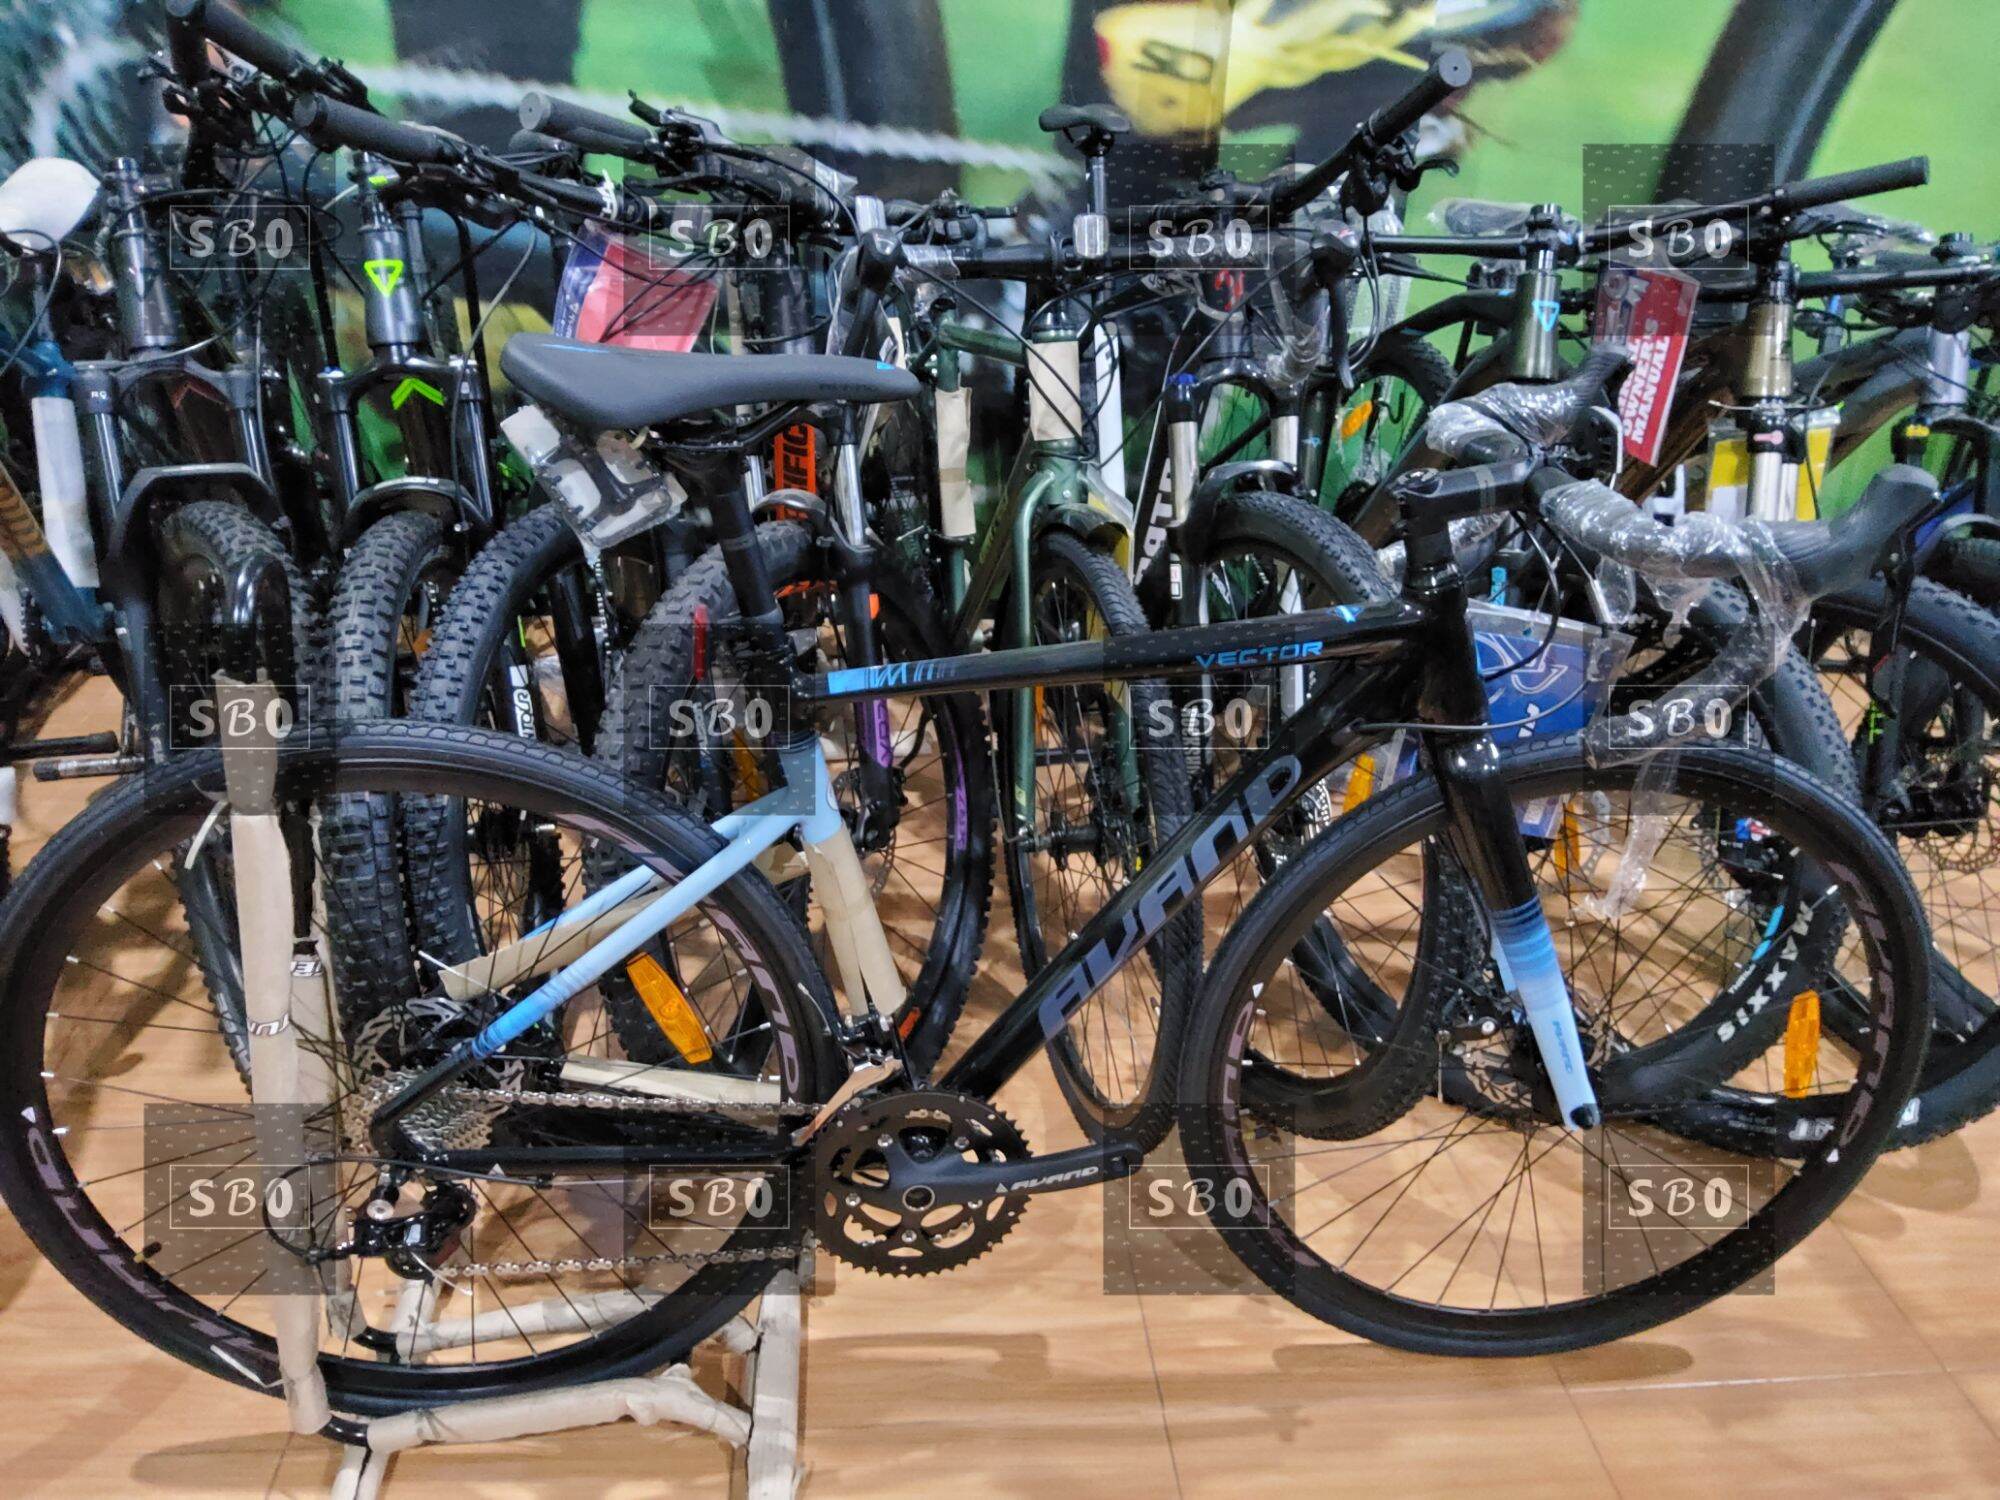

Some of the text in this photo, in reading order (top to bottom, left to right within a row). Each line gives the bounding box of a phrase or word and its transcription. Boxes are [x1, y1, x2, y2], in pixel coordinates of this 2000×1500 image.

[1631, 335, 1671, 444] MANUAL
[1195, 641, 1323, 669] VECTOR
[1038, 754, 1302, 1041] AVAND
[1010, 1166, 1099, 1192] AVAND
